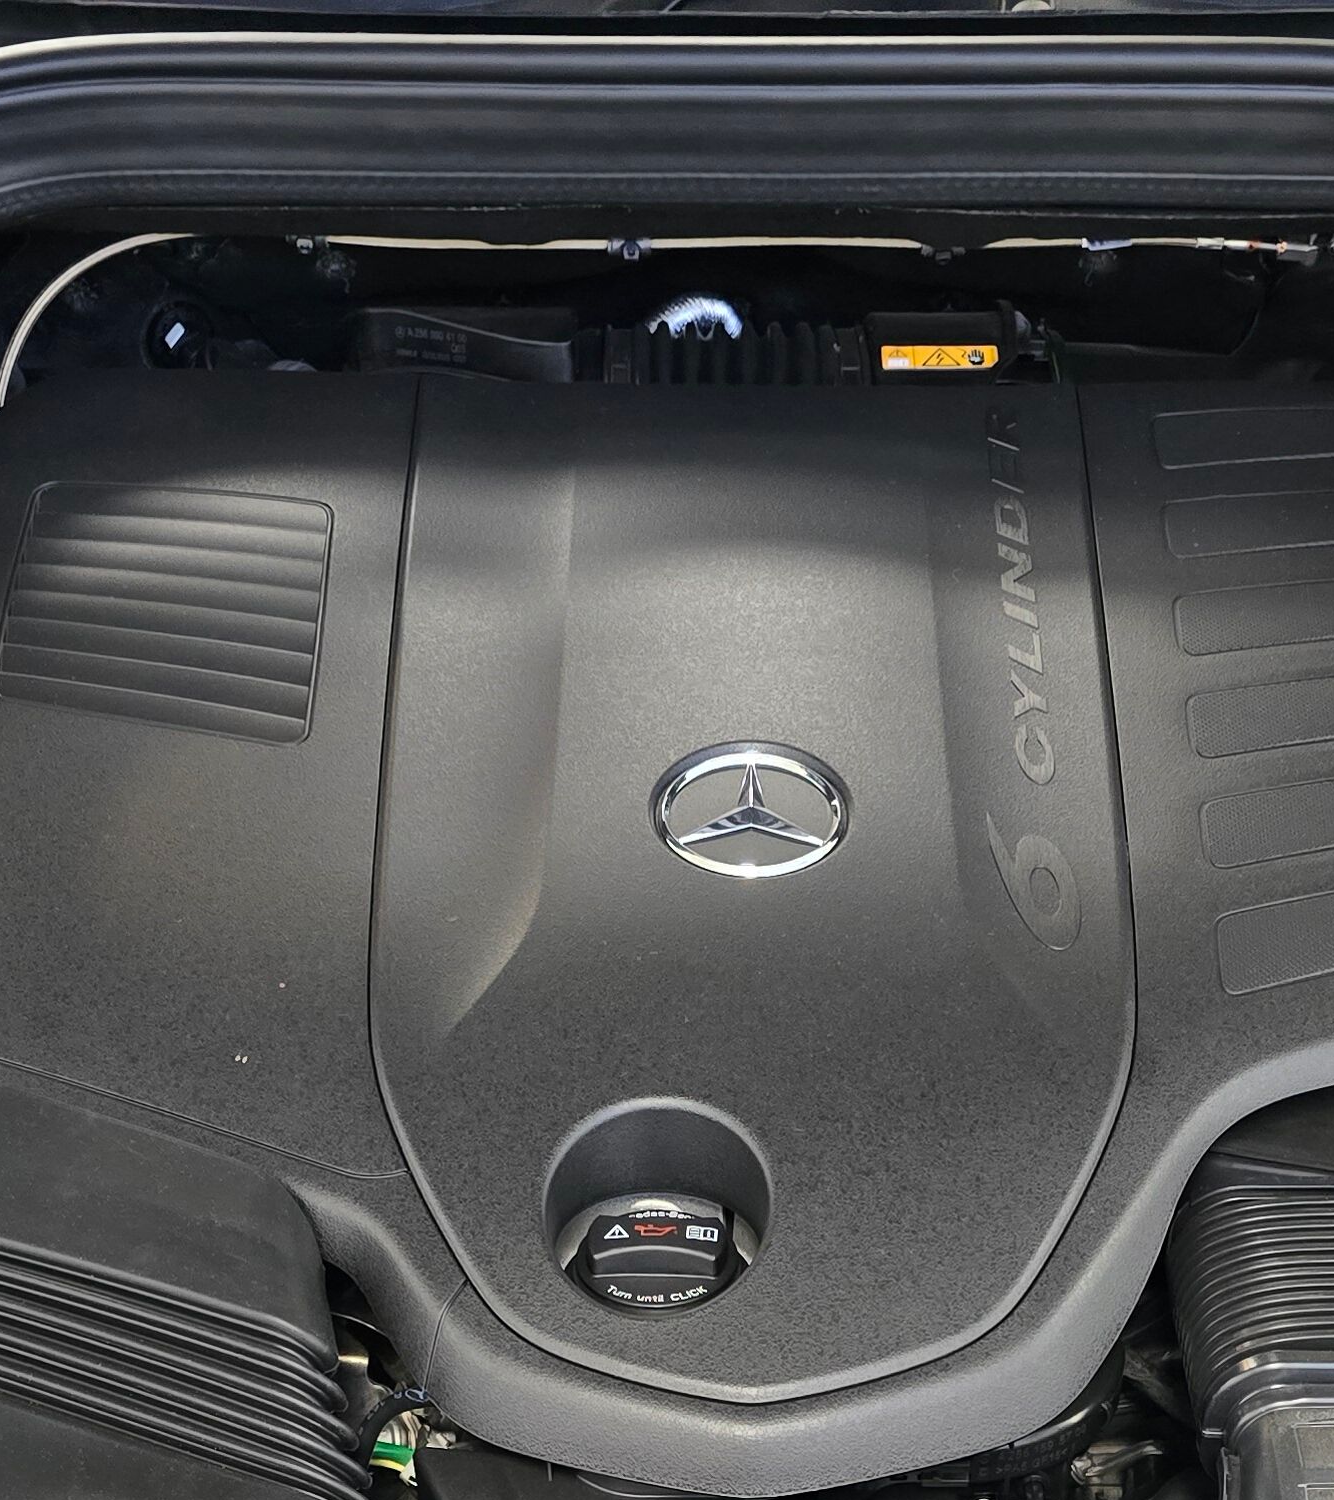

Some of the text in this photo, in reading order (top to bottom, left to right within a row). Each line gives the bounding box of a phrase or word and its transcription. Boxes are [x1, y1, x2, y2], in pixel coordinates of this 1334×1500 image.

[985, 406, 1083, 951] 6 CYLINDER
[607, 1284, 708, 1303] Turn until CLICK
